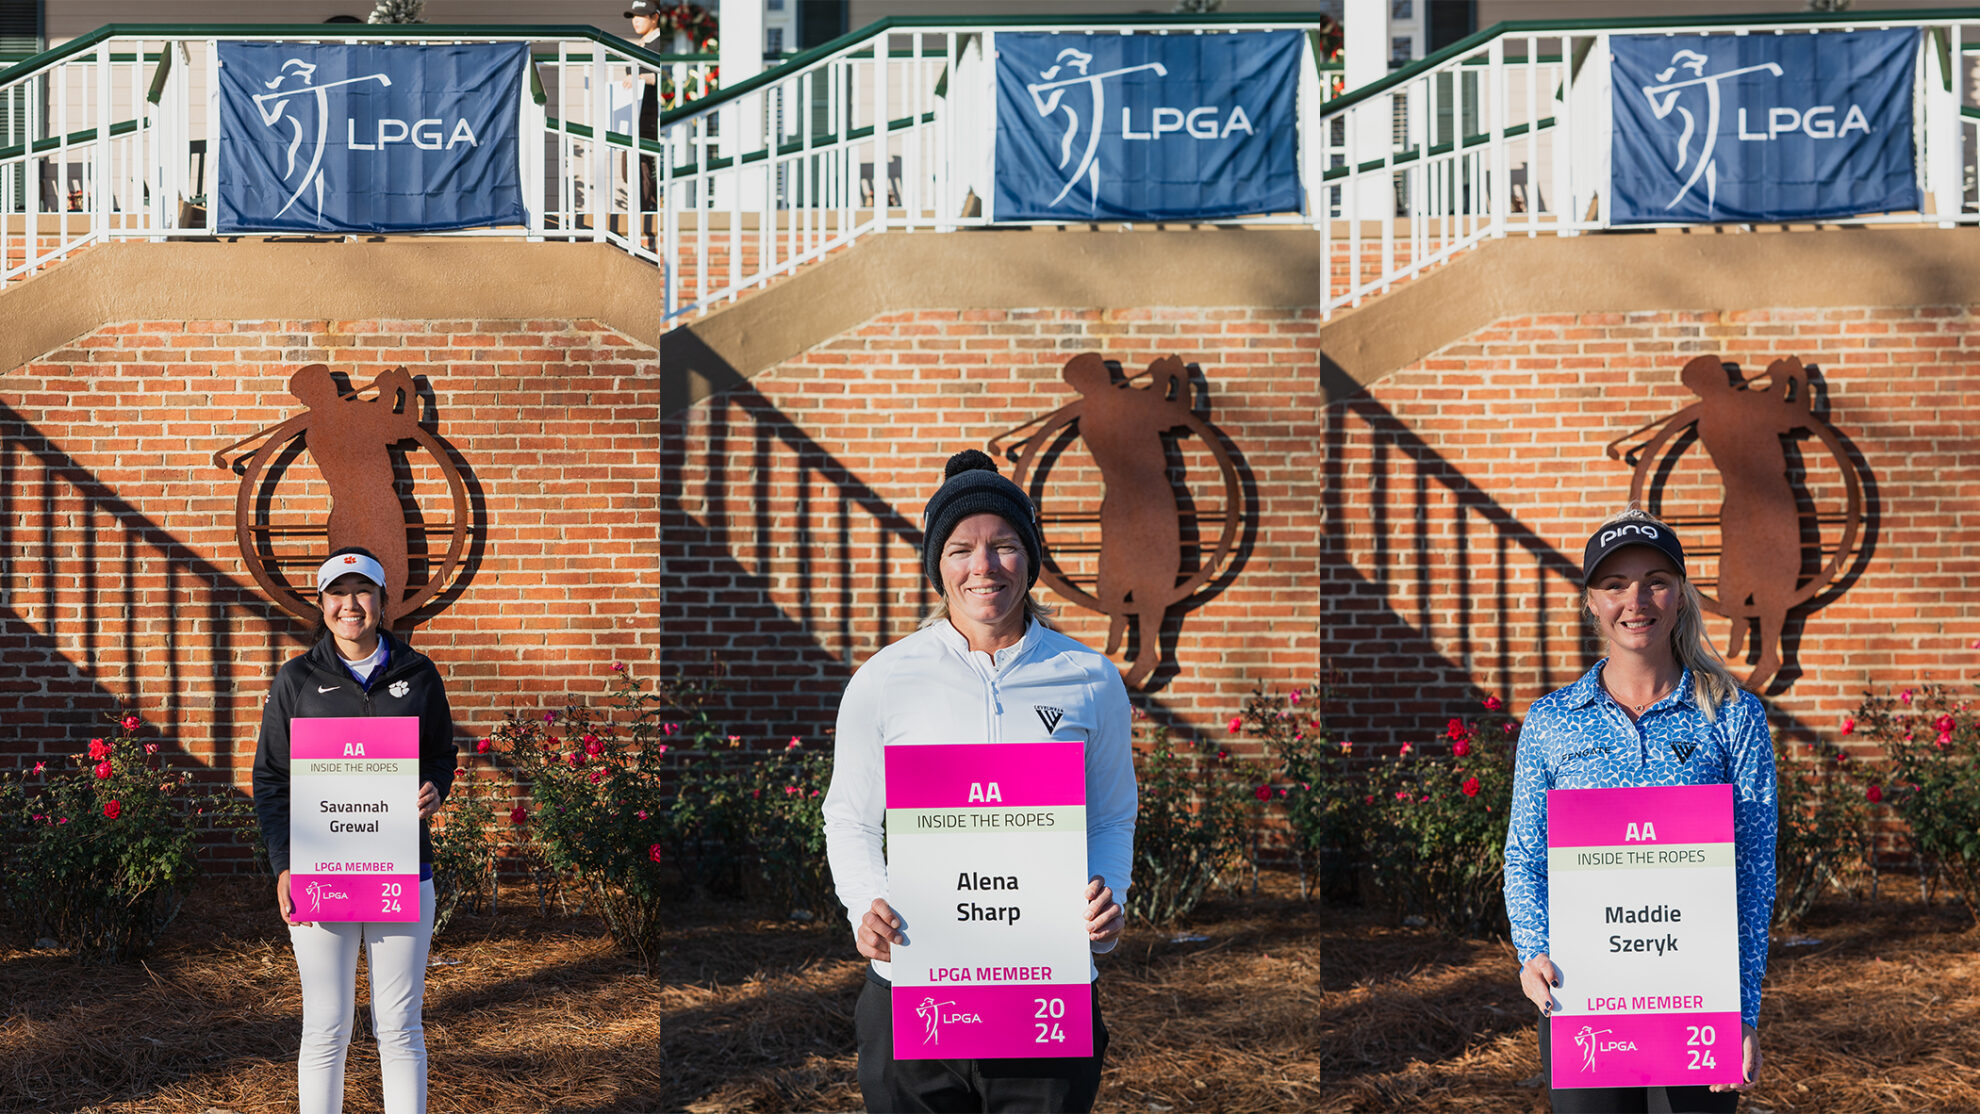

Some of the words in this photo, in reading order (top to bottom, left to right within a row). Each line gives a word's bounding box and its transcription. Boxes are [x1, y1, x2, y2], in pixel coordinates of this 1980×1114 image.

[1122, 105, 1254, 140] LPGA
[1738, 104, 1871, 141] LPGA
[348, 117, 480, 151] LPGA
[343, 743, 365, 756] AA
[310, 763, 342, 772] INSIDE
[345, 763, 364, 772] THE
[366, 763, 398, 772] ROPES
[968, 782, 1002, 803] AA
[320, 800, 389, 813] Savannah
[329, 820, 379, 833] Grewal
[917, 814, 967, 828] INSIDE
[970, 814, 1000, 827] THE
[1004, 813, 1055, 827] ROPES
[1625, 822, 1657, 842] AA
[1577, 852, 1624, 865] INSIDE
[1627, 851, 1655, 864] THE
[1658, 850, 1706, 863] ROPES
[315, 862, 342, 872] LPGA
[345, 862, 394, 872] MEMBER
[381, 883, 402, 897] 20
[957, 872, 1019, 891] Alena
[381, 899, 402, 913] 24
[957, 902, 1021, 926] Sharp
[1605, 905, 1682, 924] Maddie
[1609, 933, 1679, 957] Szeryk
[929, 968, 971, 982] LPGA
[976, 966, 1052, 981] MEMBER
[1034, 998, 1065, 1018] 20
[1587, 997, 1627, 1011] LPGA
[1632, 995, 1703, 1010] MEMBER
[943, 1013, 982, 1024] LPGA
[1034, 1023, 1065, 1043] 24
[1686, 1025, 1716, 1046] 20
[1600, 1041, 1638, 1052] LPGA
[1687, 1050, 1717, 1070] 24
